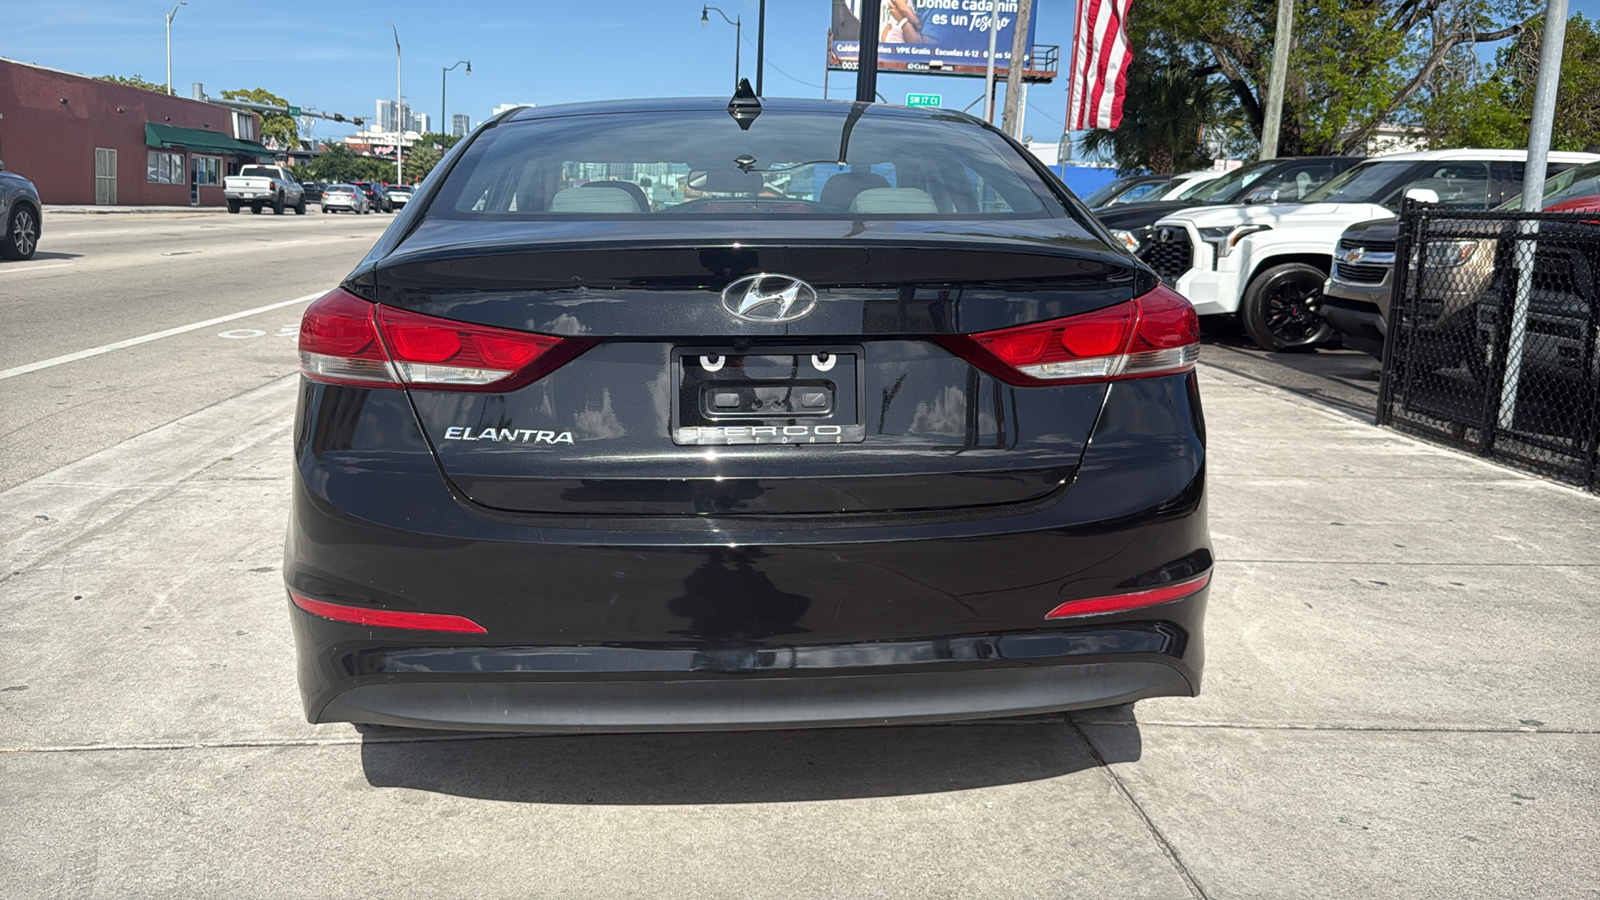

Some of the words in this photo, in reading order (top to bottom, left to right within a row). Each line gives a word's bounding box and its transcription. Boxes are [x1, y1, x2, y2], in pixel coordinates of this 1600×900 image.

[962, 0, 994, 12] cada
[997, 0, 1019, 13] niñ
[931, 14, 948, 25] es
[951, 15, 968, 26] un
[896, 46, 911, 54] VPK
[911, 47, 931, 56] Gratis
[935, 48, 964, 57] Escuelas
[964, 49, 979, 58] K-12
[983, 50, 1003, 59] Bas
[909, 96, 920, 104] SW
[921, 96, 929, 104] 17
[444, 426, 575, 446] ELANTRA
